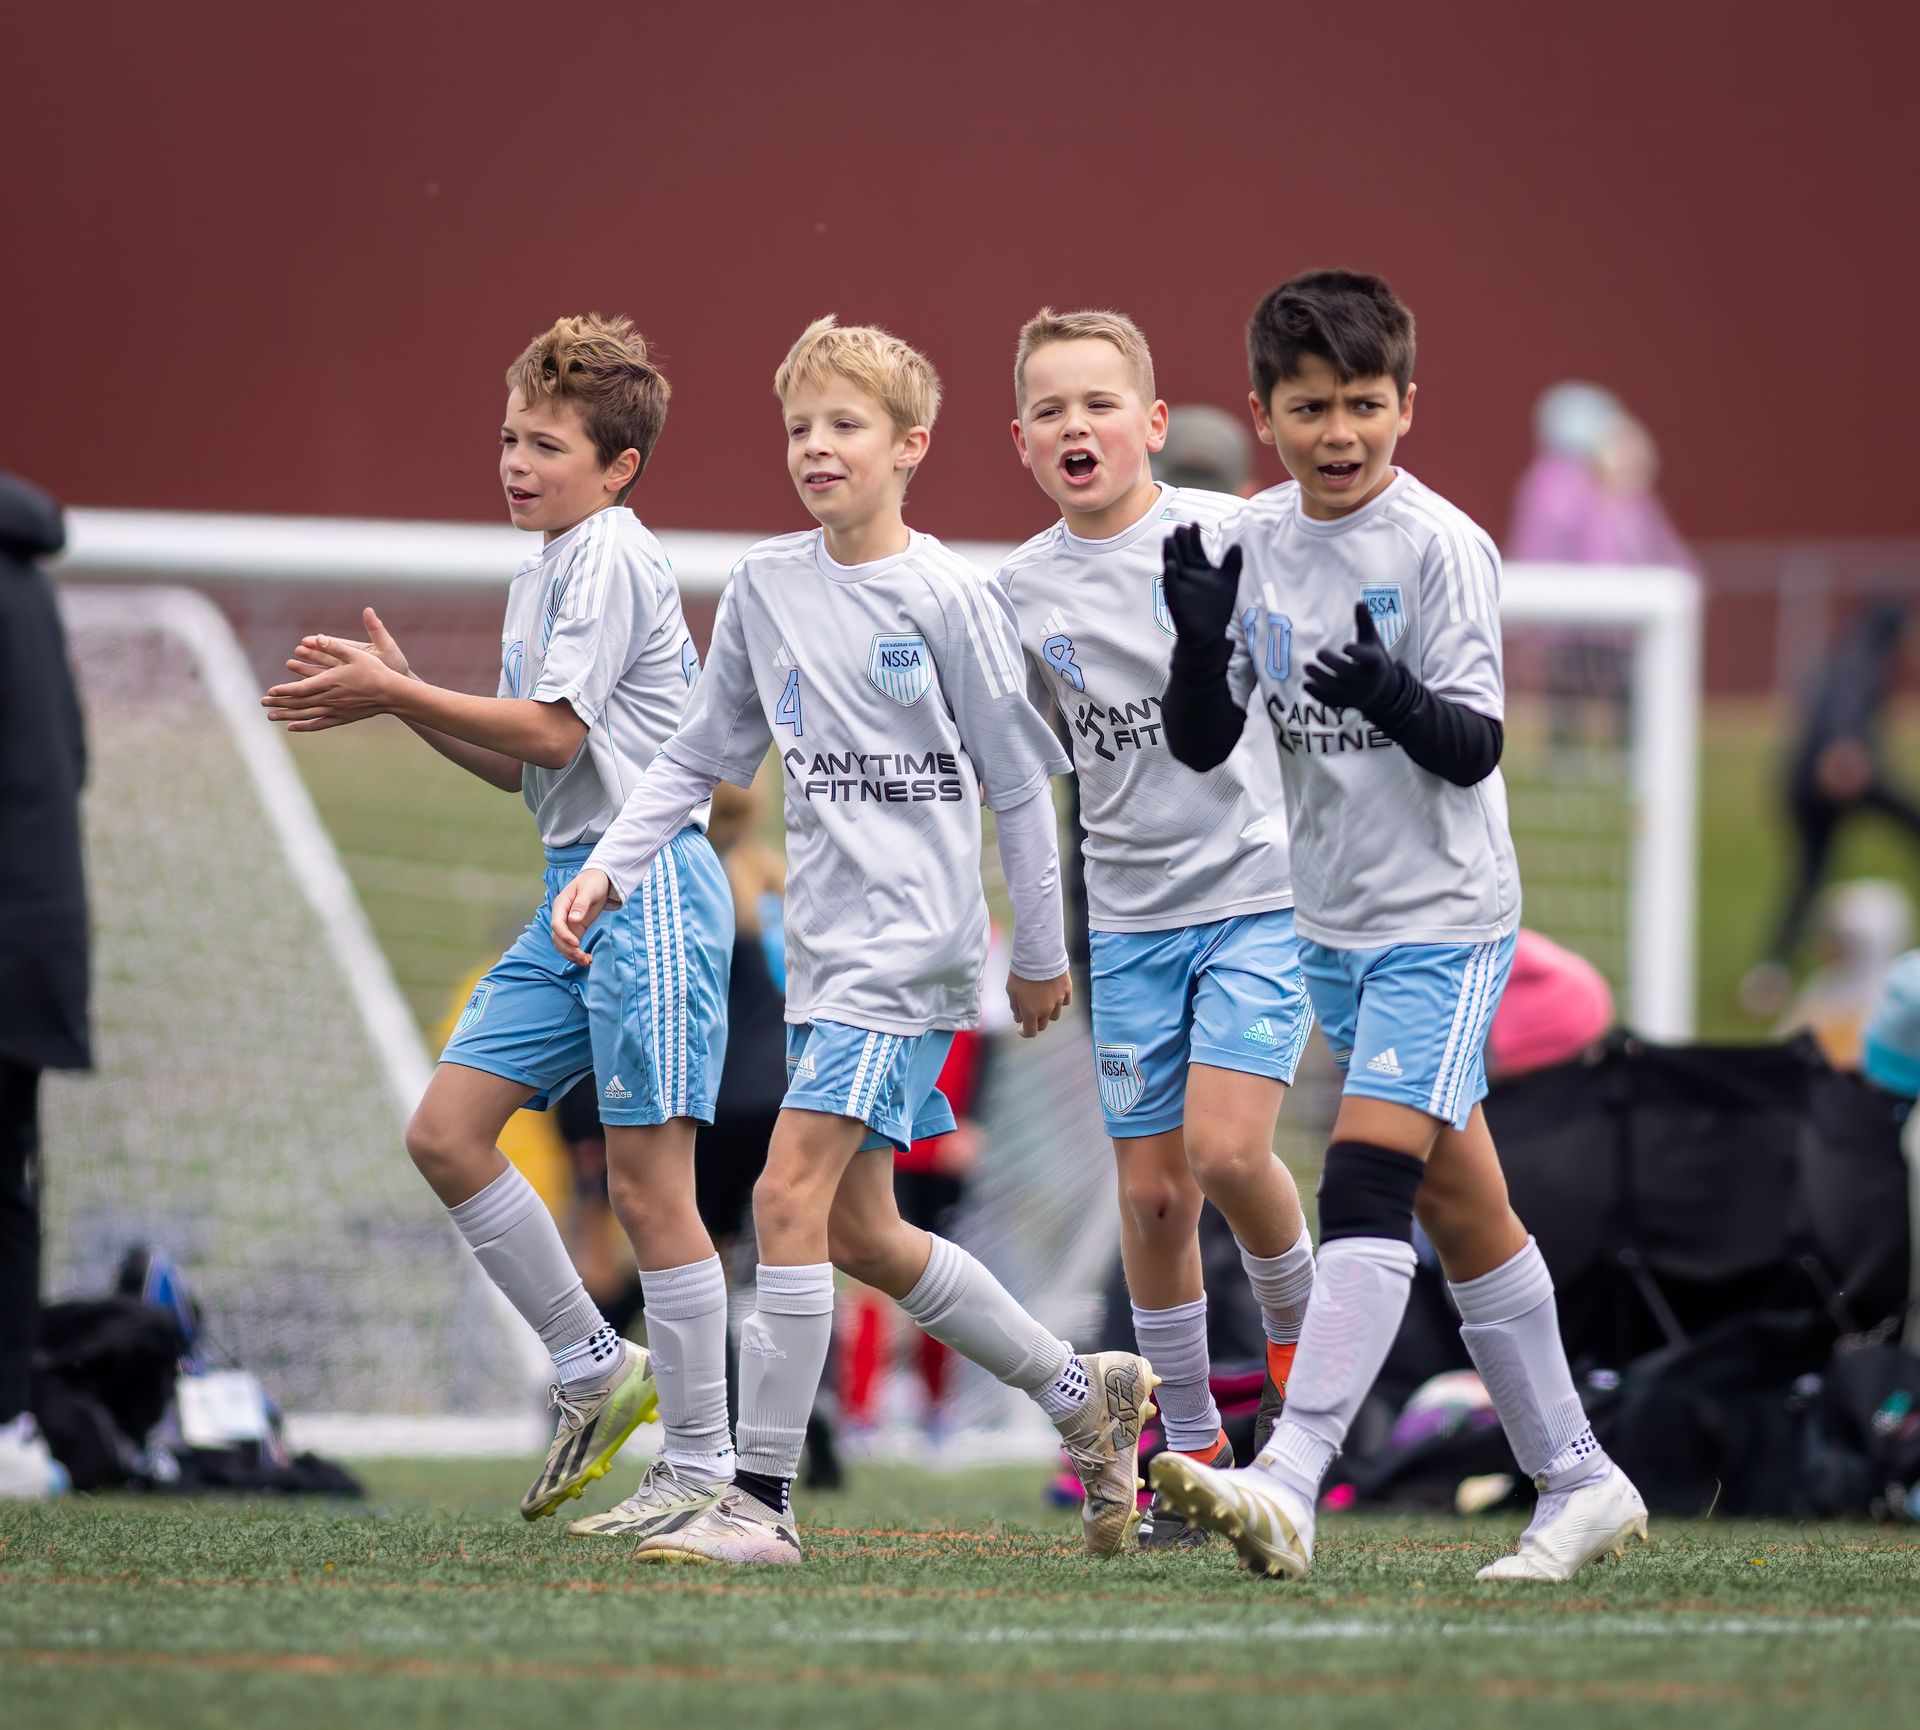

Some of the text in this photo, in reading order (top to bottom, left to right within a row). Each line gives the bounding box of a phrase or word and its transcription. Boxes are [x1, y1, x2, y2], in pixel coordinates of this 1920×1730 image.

[1241, 607, 1293, 680] 10
[881, 650, 921, 667] NSSA
[775, 669, 803, 737] 4
[1288, 727, 1393, 753] FITNE
[808, 751, 959, 776] ANYTIME
[805, 779, 963, 803] FITNESS
[1101, 1059, 1129, 1077] NSSA
